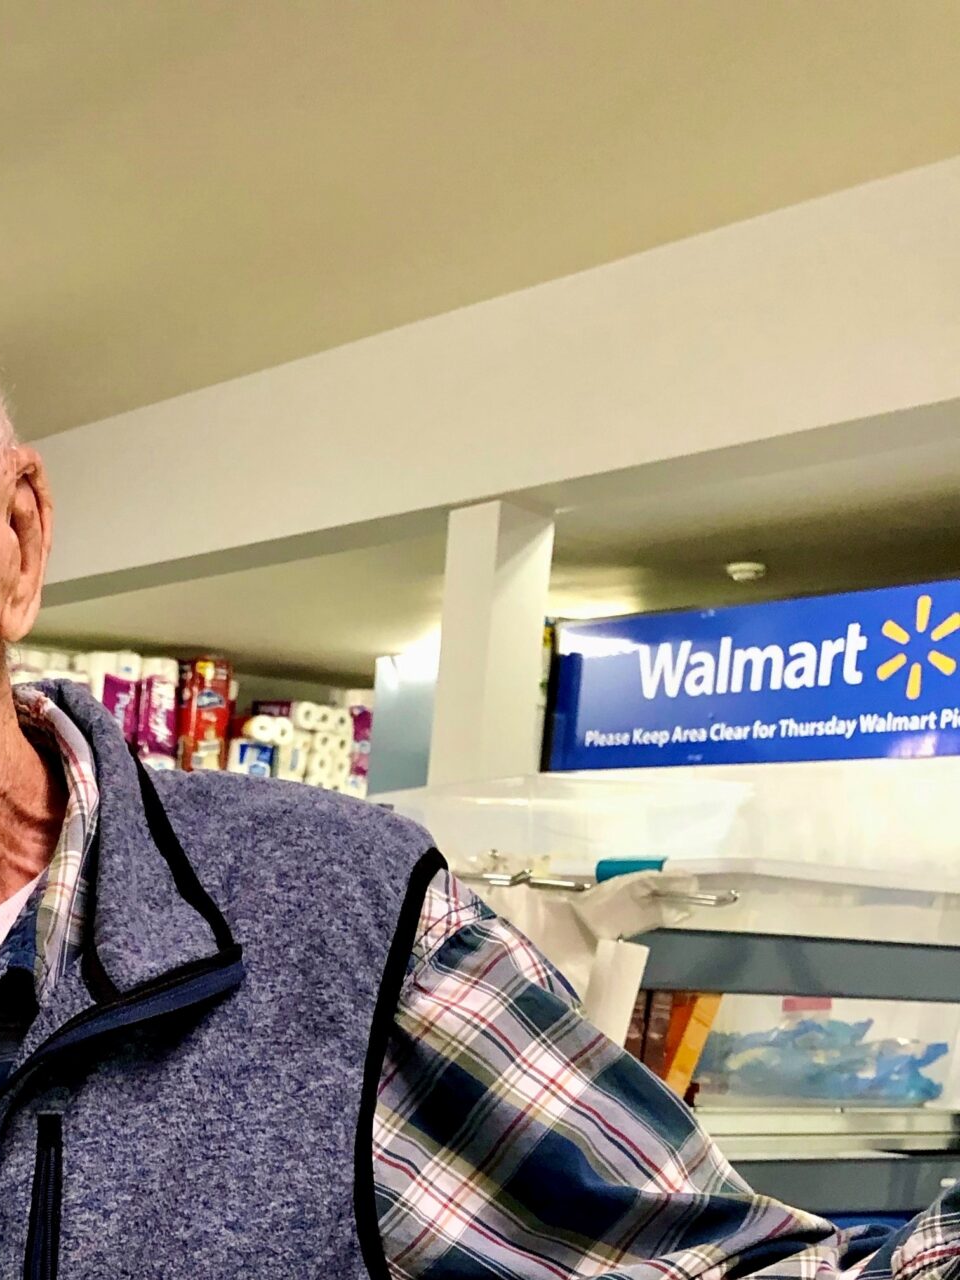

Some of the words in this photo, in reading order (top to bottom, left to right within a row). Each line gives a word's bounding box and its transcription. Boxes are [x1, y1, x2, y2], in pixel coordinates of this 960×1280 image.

[638, 622, 868, 700] Walmart
[584, 730, 631, 747] Please
[632, 728, 670, 748] Keep
[671, 725, 708, 743] Area
[709, 722, 751, 741] Clear
[752, 720, 777, 739] for
[778, 715, 857, 739] Thursday
[859, 711, 938, 733] Walmart
